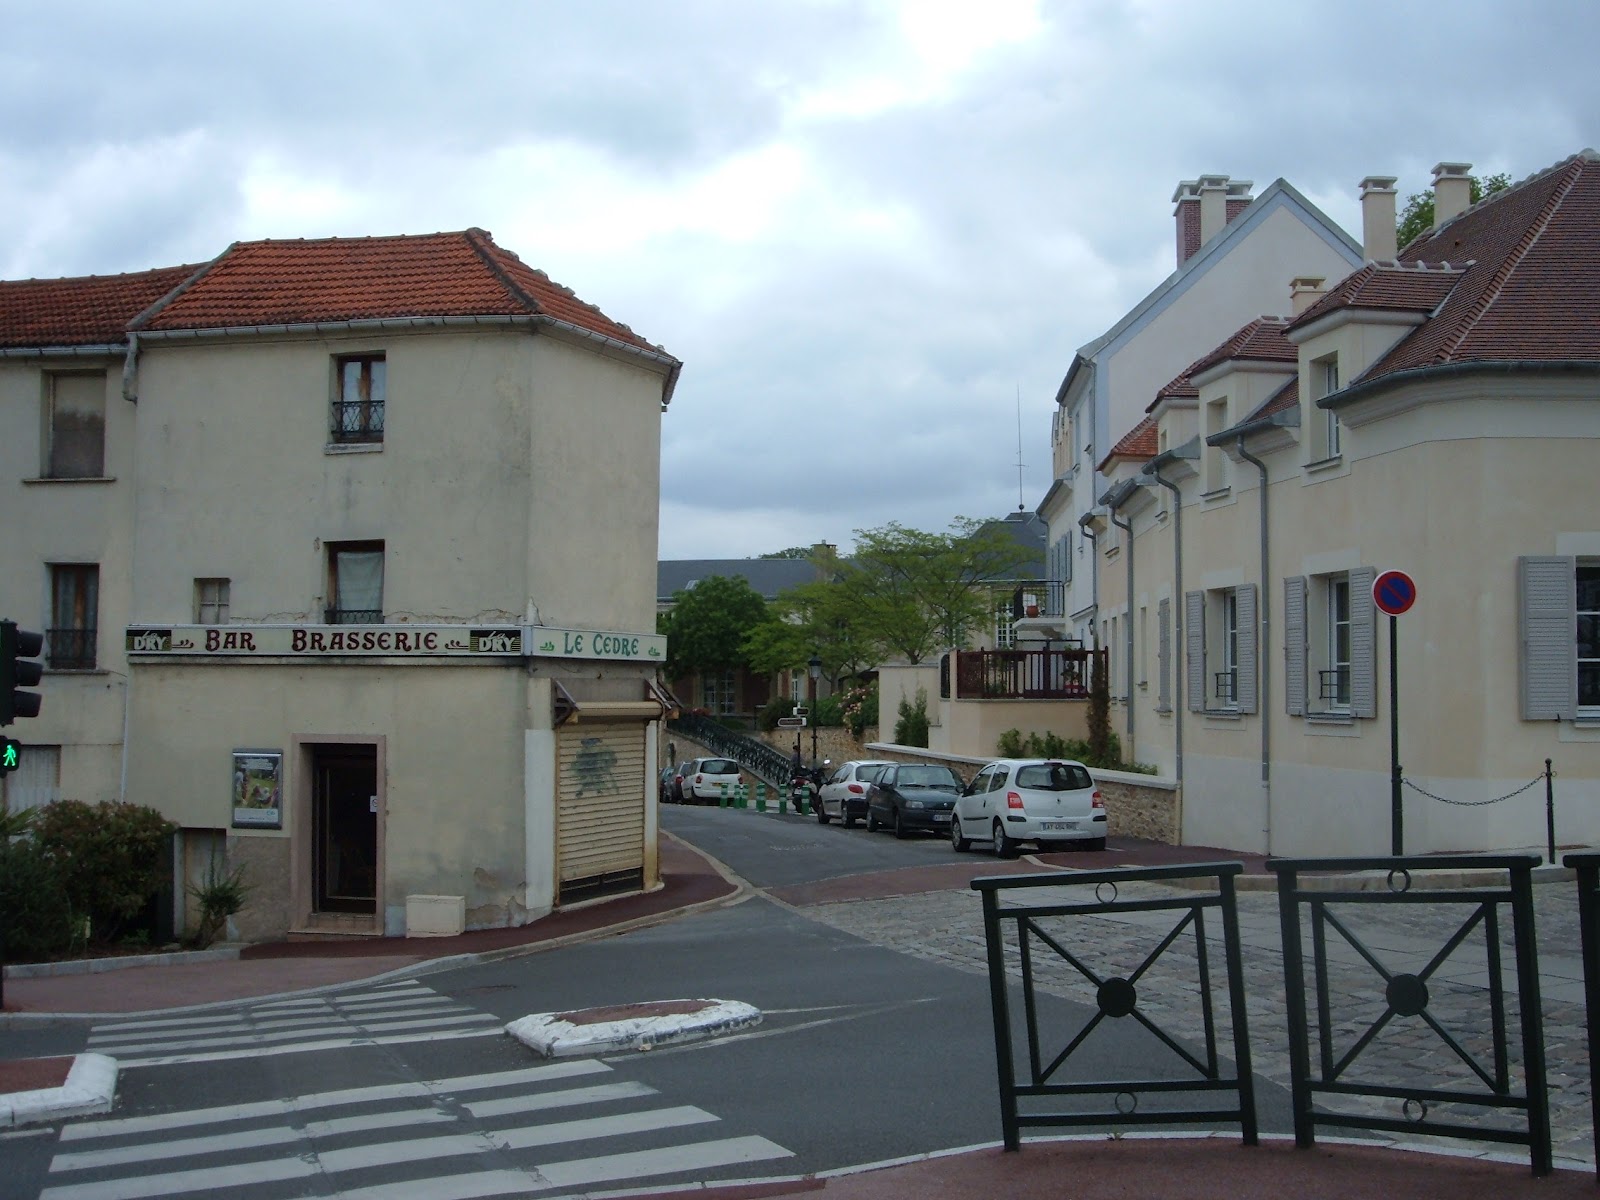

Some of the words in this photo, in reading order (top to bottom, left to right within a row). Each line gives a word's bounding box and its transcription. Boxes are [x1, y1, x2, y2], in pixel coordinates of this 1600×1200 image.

[133, 635, 168, 651] DRY
[205, 629, 256, 652] BAR
[291, 629, 438, 652] BRASSERIE
[478, 636, 516, 652] DRY
[564, 632, 583, 655] LE
[593, 633, 639, 657] CEDRE
